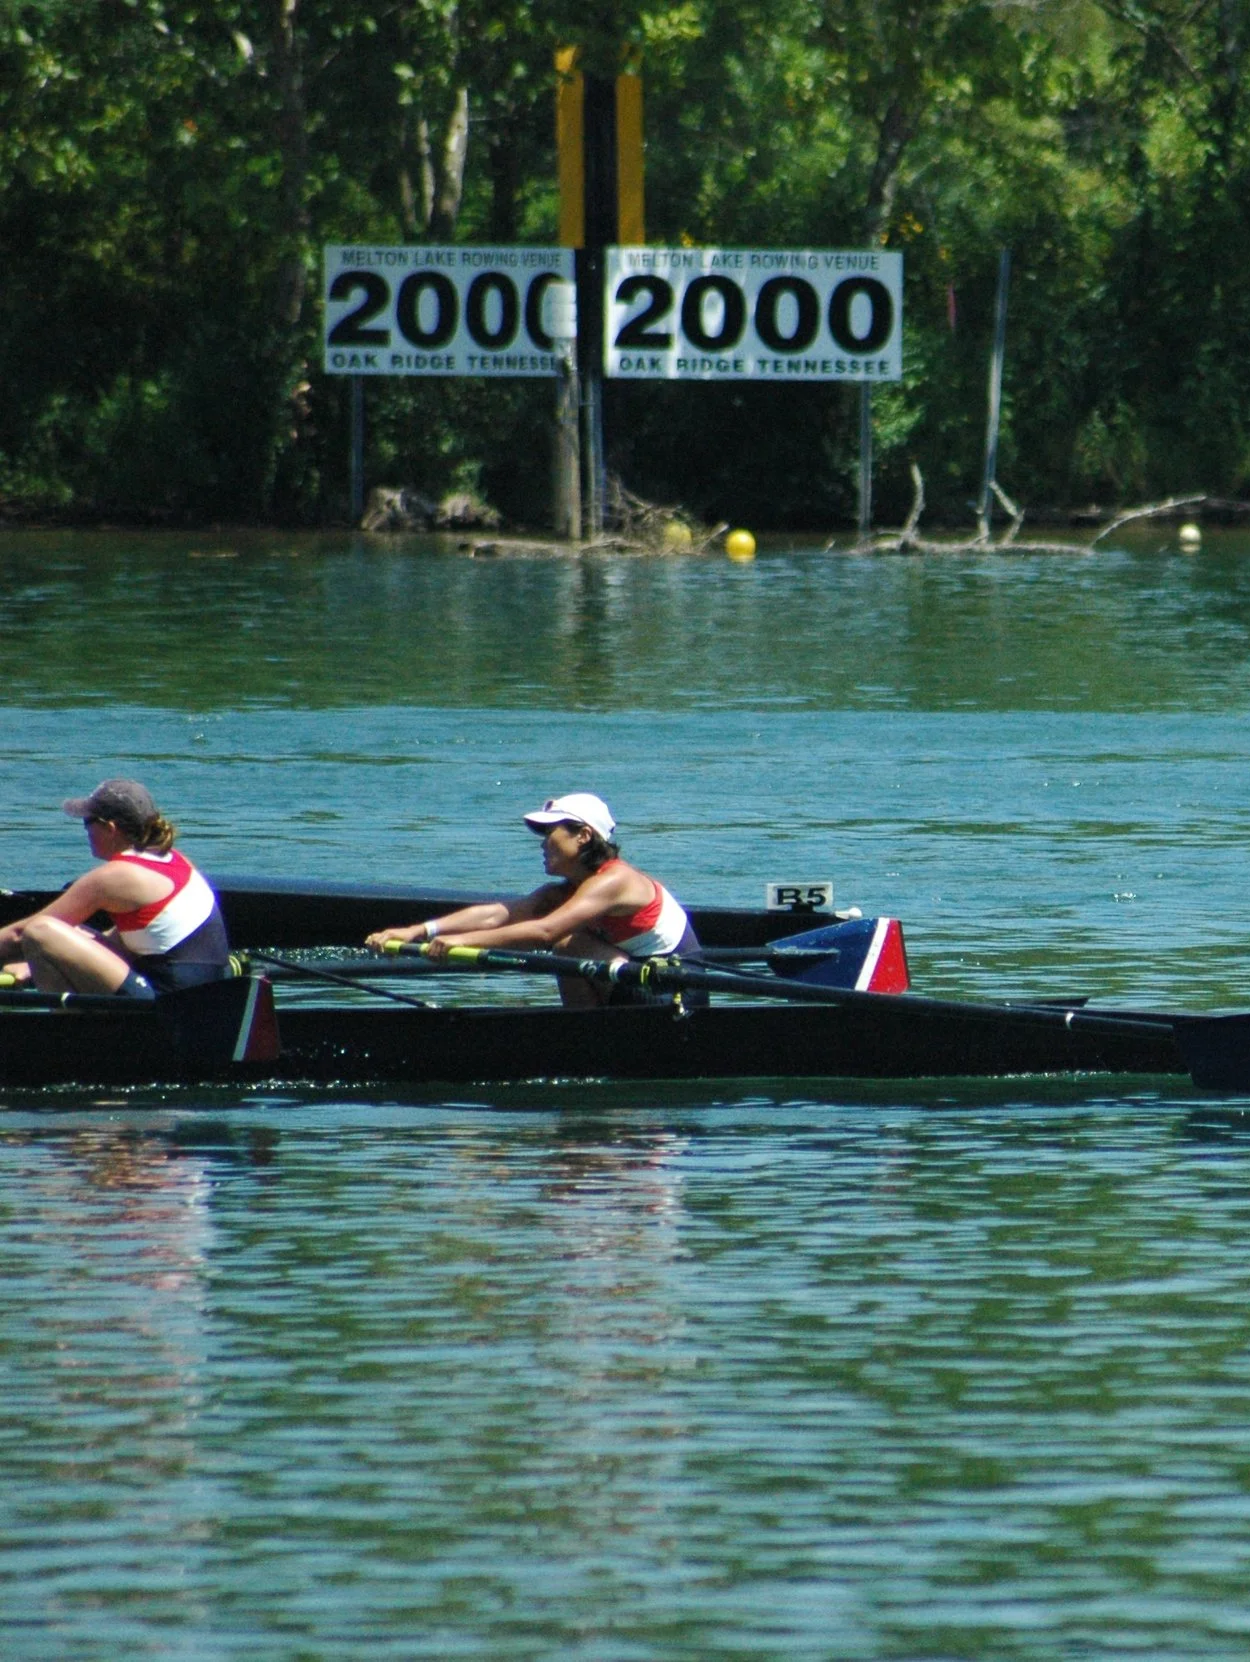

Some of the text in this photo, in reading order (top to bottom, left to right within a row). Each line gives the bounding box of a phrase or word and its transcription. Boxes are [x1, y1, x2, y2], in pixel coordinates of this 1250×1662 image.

[342, 251, 561, 267] MELTON LAKE ROWING VENUE
[627, 252, 880, 270] MELTON LAKE ROWING VENUE
[614, 275, 893, 354] 2000
[332, 354, 378, 369] OAK
[391, 354, 456, 370] RIDGE
[619, 358, 891, 375] OAK RIDGE TENNESSEE
[777, 887, 826, 906] B5
